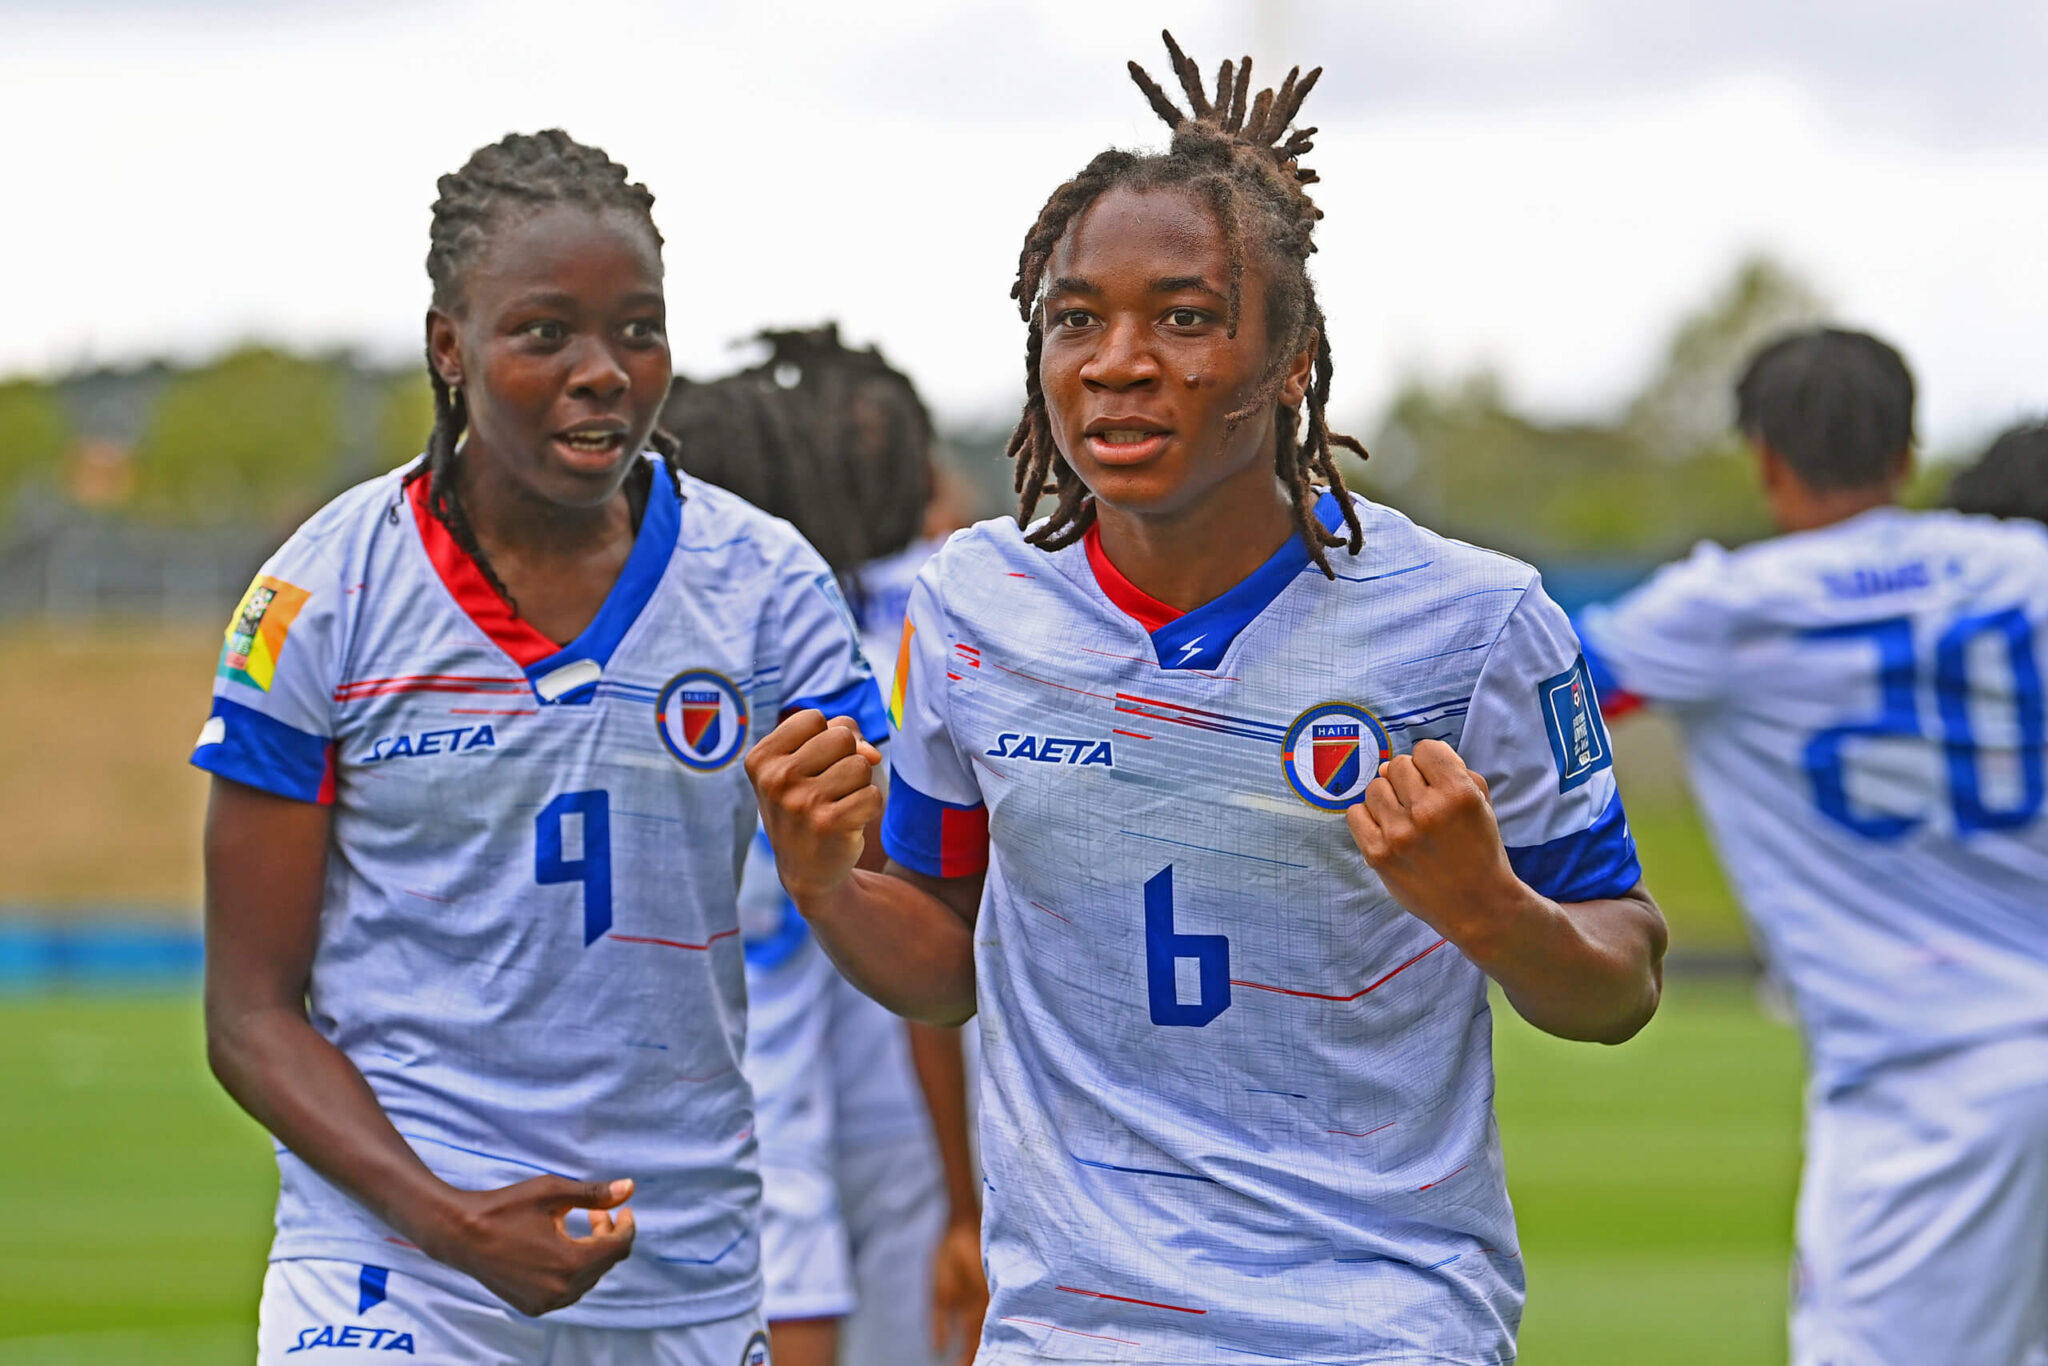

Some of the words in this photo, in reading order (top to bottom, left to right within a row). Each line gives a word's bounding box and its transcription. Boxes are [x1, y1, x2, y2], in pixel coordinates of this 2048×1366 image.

[361, 724, 496, 763] SAETA
[1318, 726, 1355, 737] HAITI
[1795, 606, 2045, 842] 20
[984, 732, 1114, 767] SAETA
[535, 789, 612, 947] 9
[1144, 864, 1231, 1027] 6
[286, 1325, 416, 1355] SAETA
